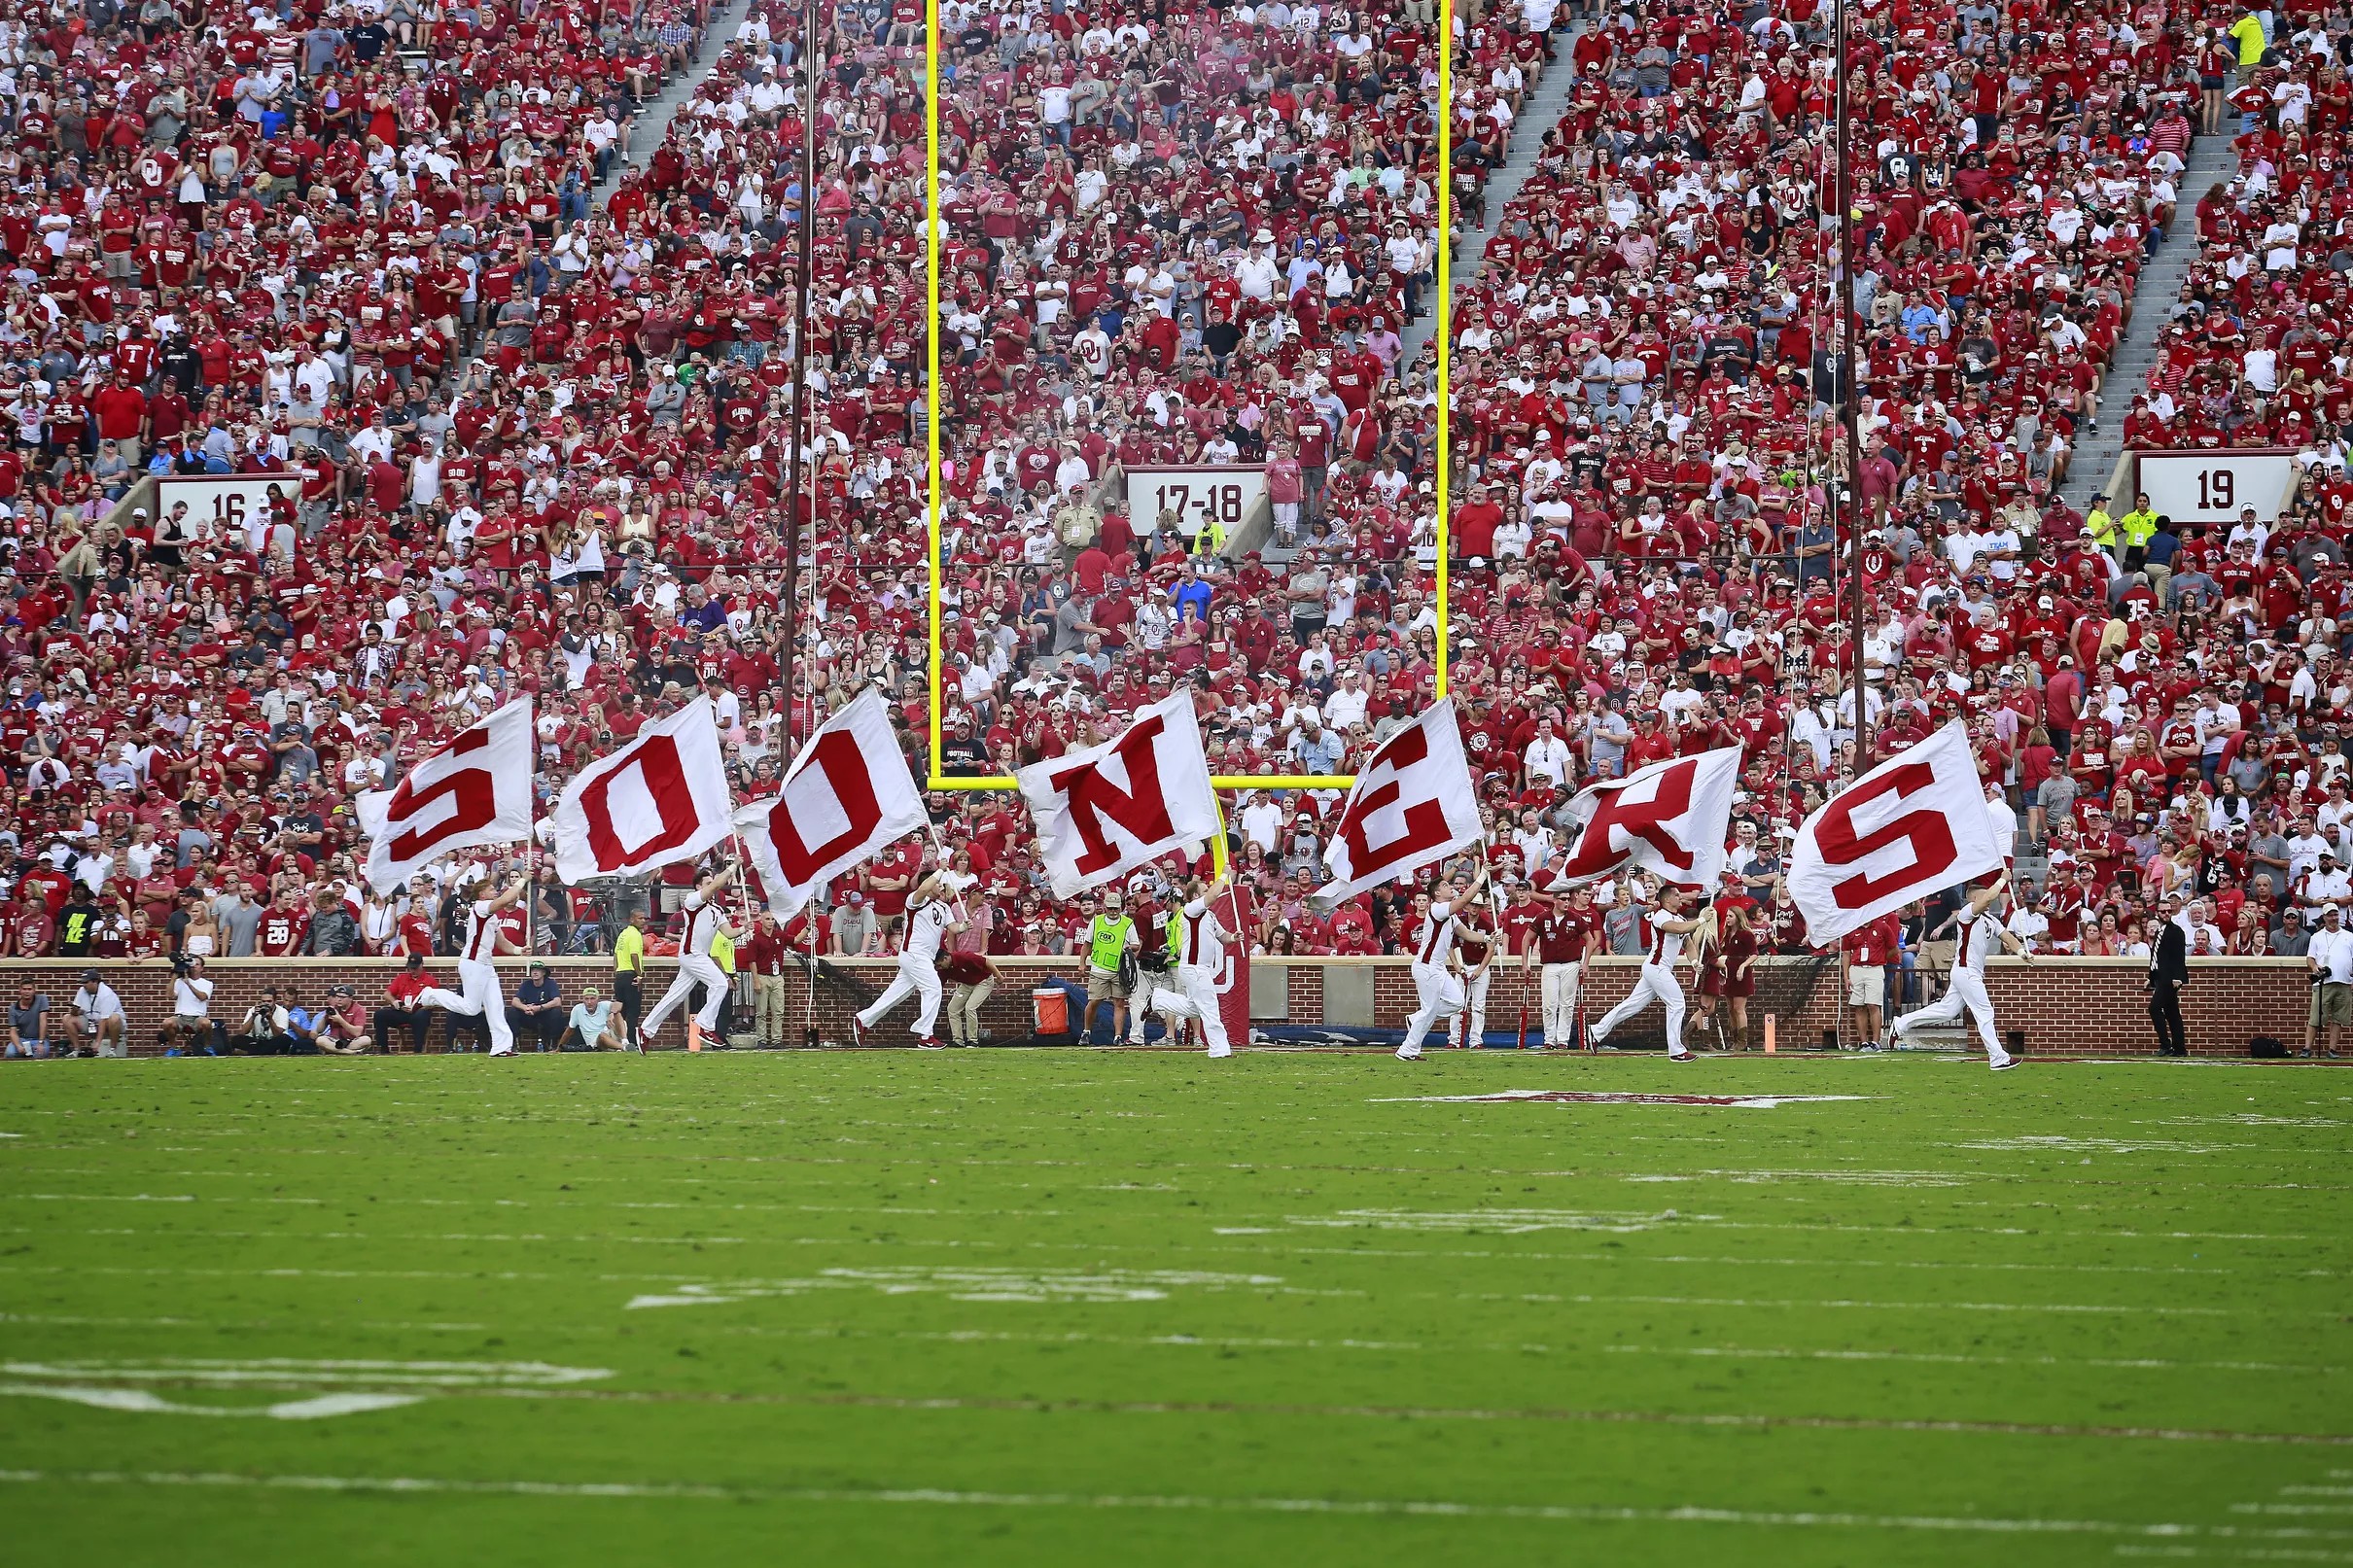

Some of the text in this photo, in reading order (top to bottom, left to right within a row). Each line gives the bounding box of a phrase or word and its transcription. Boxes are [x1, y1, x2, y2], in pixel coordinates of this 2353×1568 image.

[1300, 17, 1310, 29] 12
[141, 159, 162, 188] OU
[1785, 186, 1806, 212] OU
[694, 314, 704, 327] OU
[1492, 311, 1507, 328] OU
[1080, 339, 1101, 365] OU
[1259, 395, 1265, 408] 1
[621, 421, 629, 435] 6
[2197, 470, 2234, 509] 19
[212, 494, 245, 530] 16
[1155, 485, 1242, 522] 17-18
[2332, 495, 2342, 510] OU
[1053, 586, 1064, 599] OU
[2126, 599, 2150, 623] 35
[703, 667, 717, 680] 00
[387, 727, 497, 862] S
[579, 735, 700, 872] O
[1049, 714, 1176, 877] N
[1336, 722, 1454, 884] E
[768, 729, 883, 887] O
[1564, 759, 1698, 879] R
[1813, 762, 1957, 909] S
[2206, 866, 2217, 885] 6
[932, 908, 941, 926] OU
[267, 927, 289, 946] 28
[1100, 932, 1111, 941] FOX
